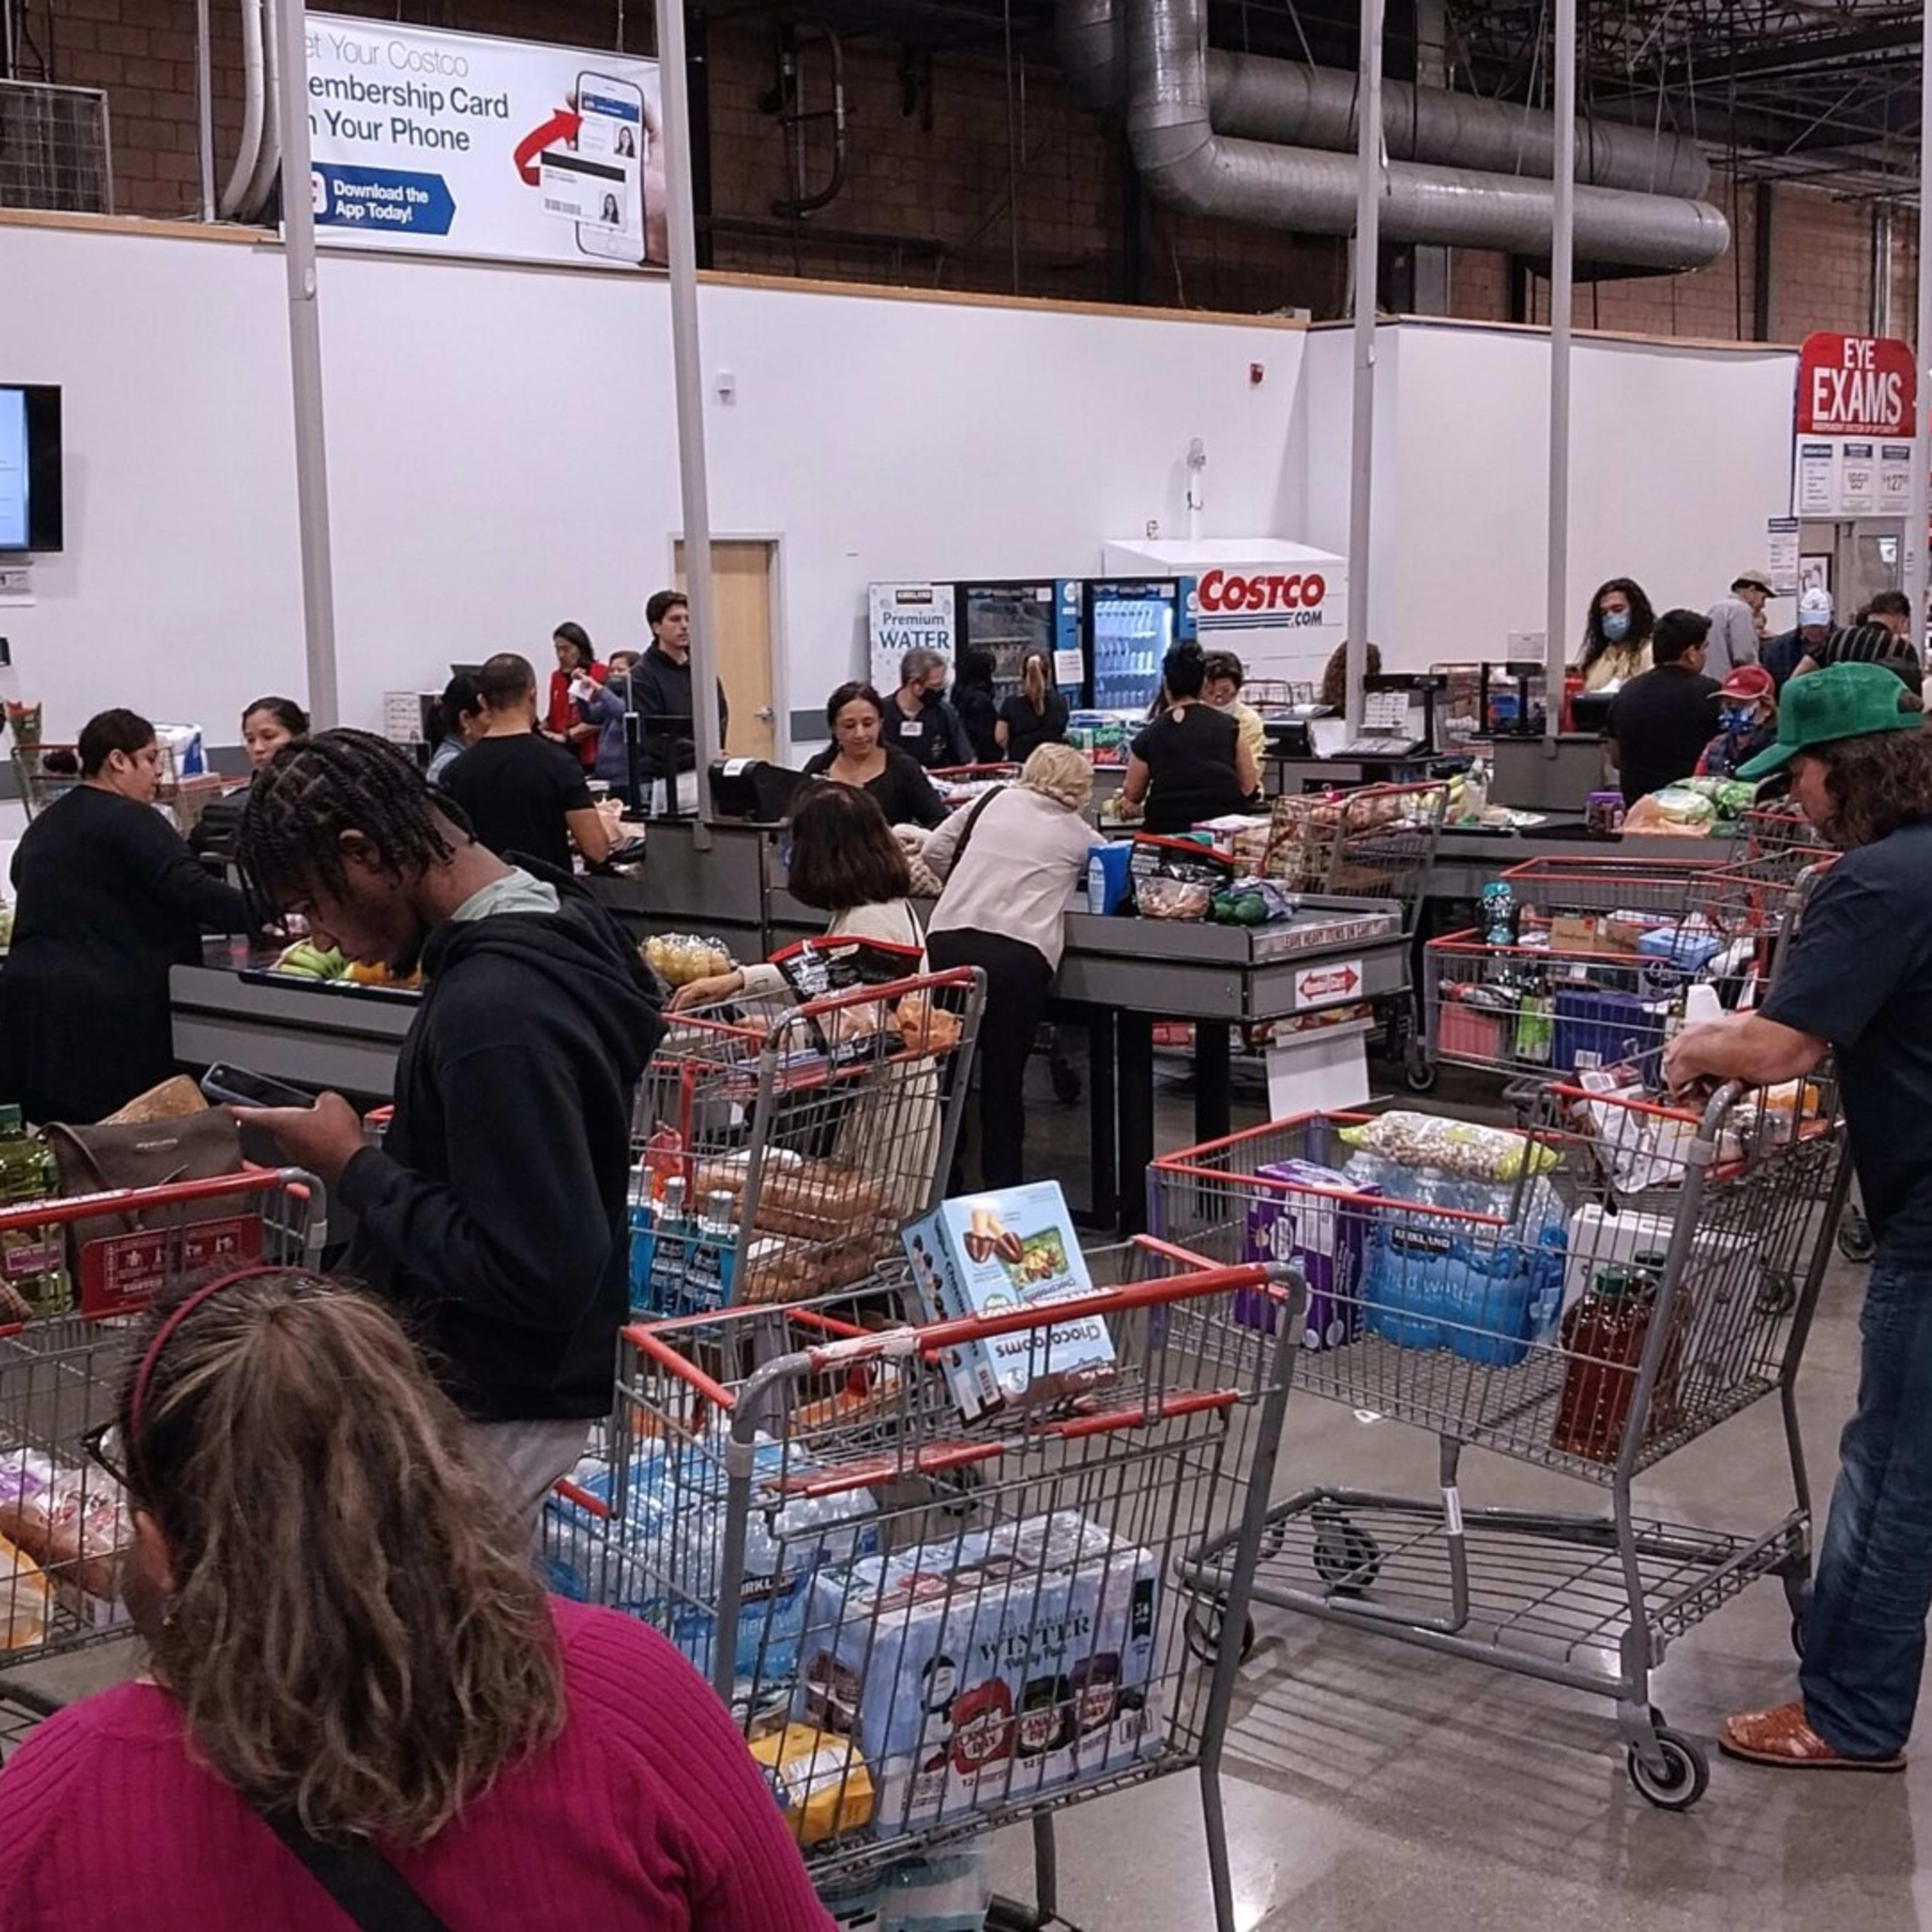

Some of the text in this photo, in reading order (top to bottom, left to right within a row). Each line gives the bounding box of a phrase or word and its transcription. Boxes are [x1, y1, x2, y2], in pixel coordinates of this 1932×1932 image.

[305, 33, 469, 77] et Your Costco
[308, 73, 509, 119] embership Card
[308, 108, 470, 151] n Your Phone
[333, 179, 429, 203] Download the
[336, 200, 414, 224] App Today!
[1843, 338, 1876, 369] EYE
[1812, 367, 1903, 425] EXAMS
[1198, 569, 1326, 612] COSTCO
[883, 611, 945, 625] Premium
[879, 630, 951, 650] WATER
[995, 1324, 1101, 1358] Chocoooms
[980, 1617, 1090, 1661] WINTER
